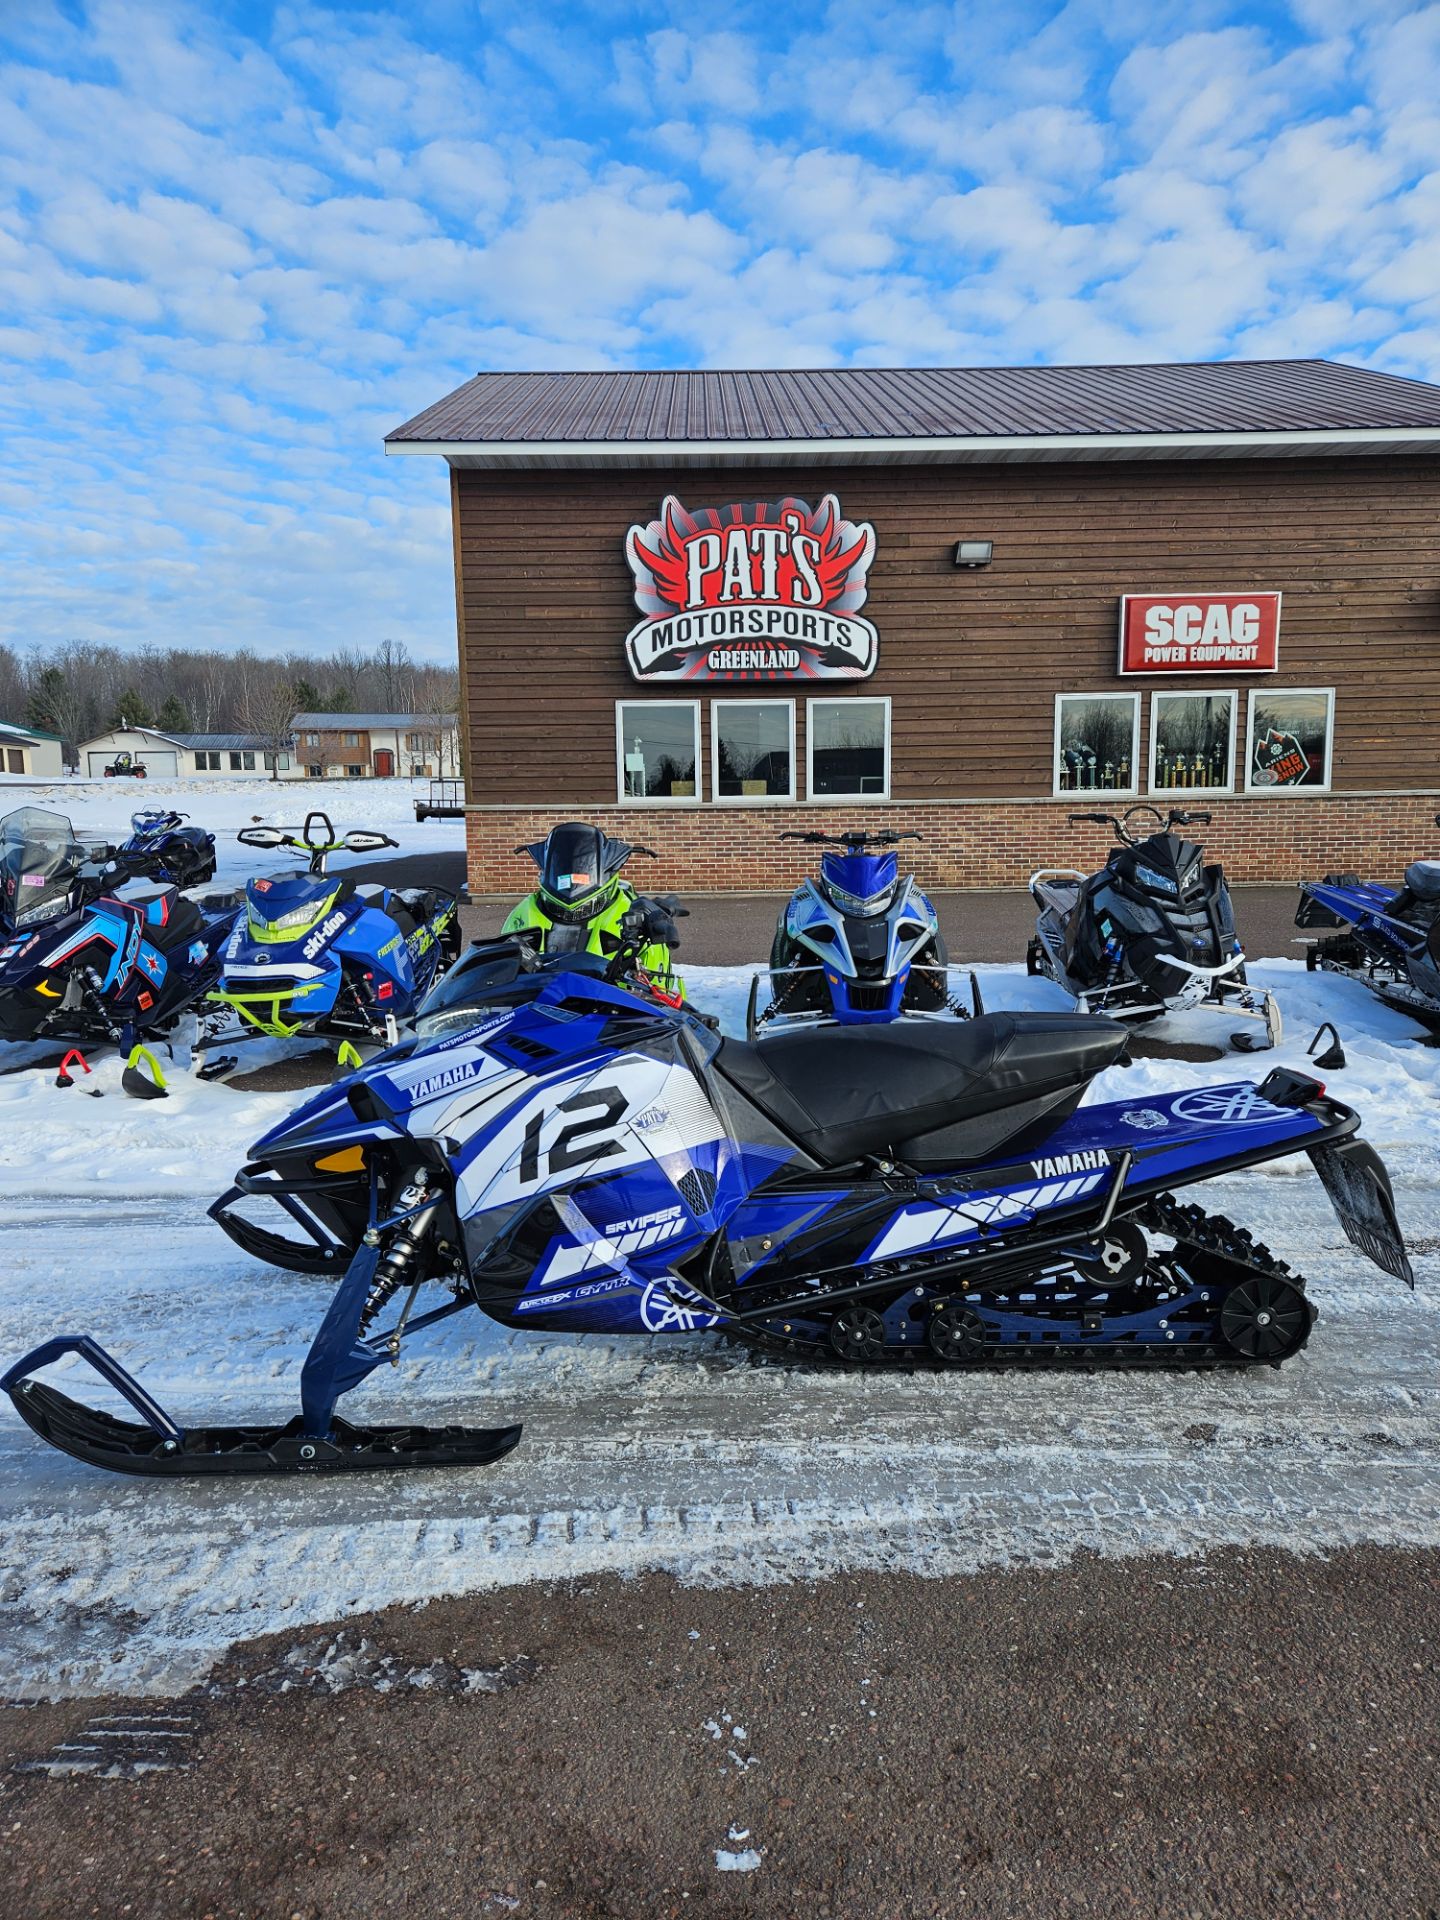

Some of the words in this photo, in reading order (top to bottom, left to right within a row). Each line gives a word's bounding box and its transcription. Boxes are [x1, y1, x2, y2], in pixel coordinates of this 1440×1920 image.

[685, 515, 822, 608] PAT'S
[651, 609, 853, 652] MOTORSPORTS
[1144, 603, 1260, 645] SCAG
[708, 649, 800, 669] GREENLAND
[1144, 646, 1187, 663] POWER
[1190, 645, 1258, 662] EQUIPMENT
[302, 911, 347, 960] ski-doo
[438, 1011, 516, 1050] PATSMOTORSPORTS.COM
[408, 1062, 476, 1101] YAMAHA
[519, 1086, 630, 1184] 12
[1030, 1148, 1111, 1180] YAMAHA
